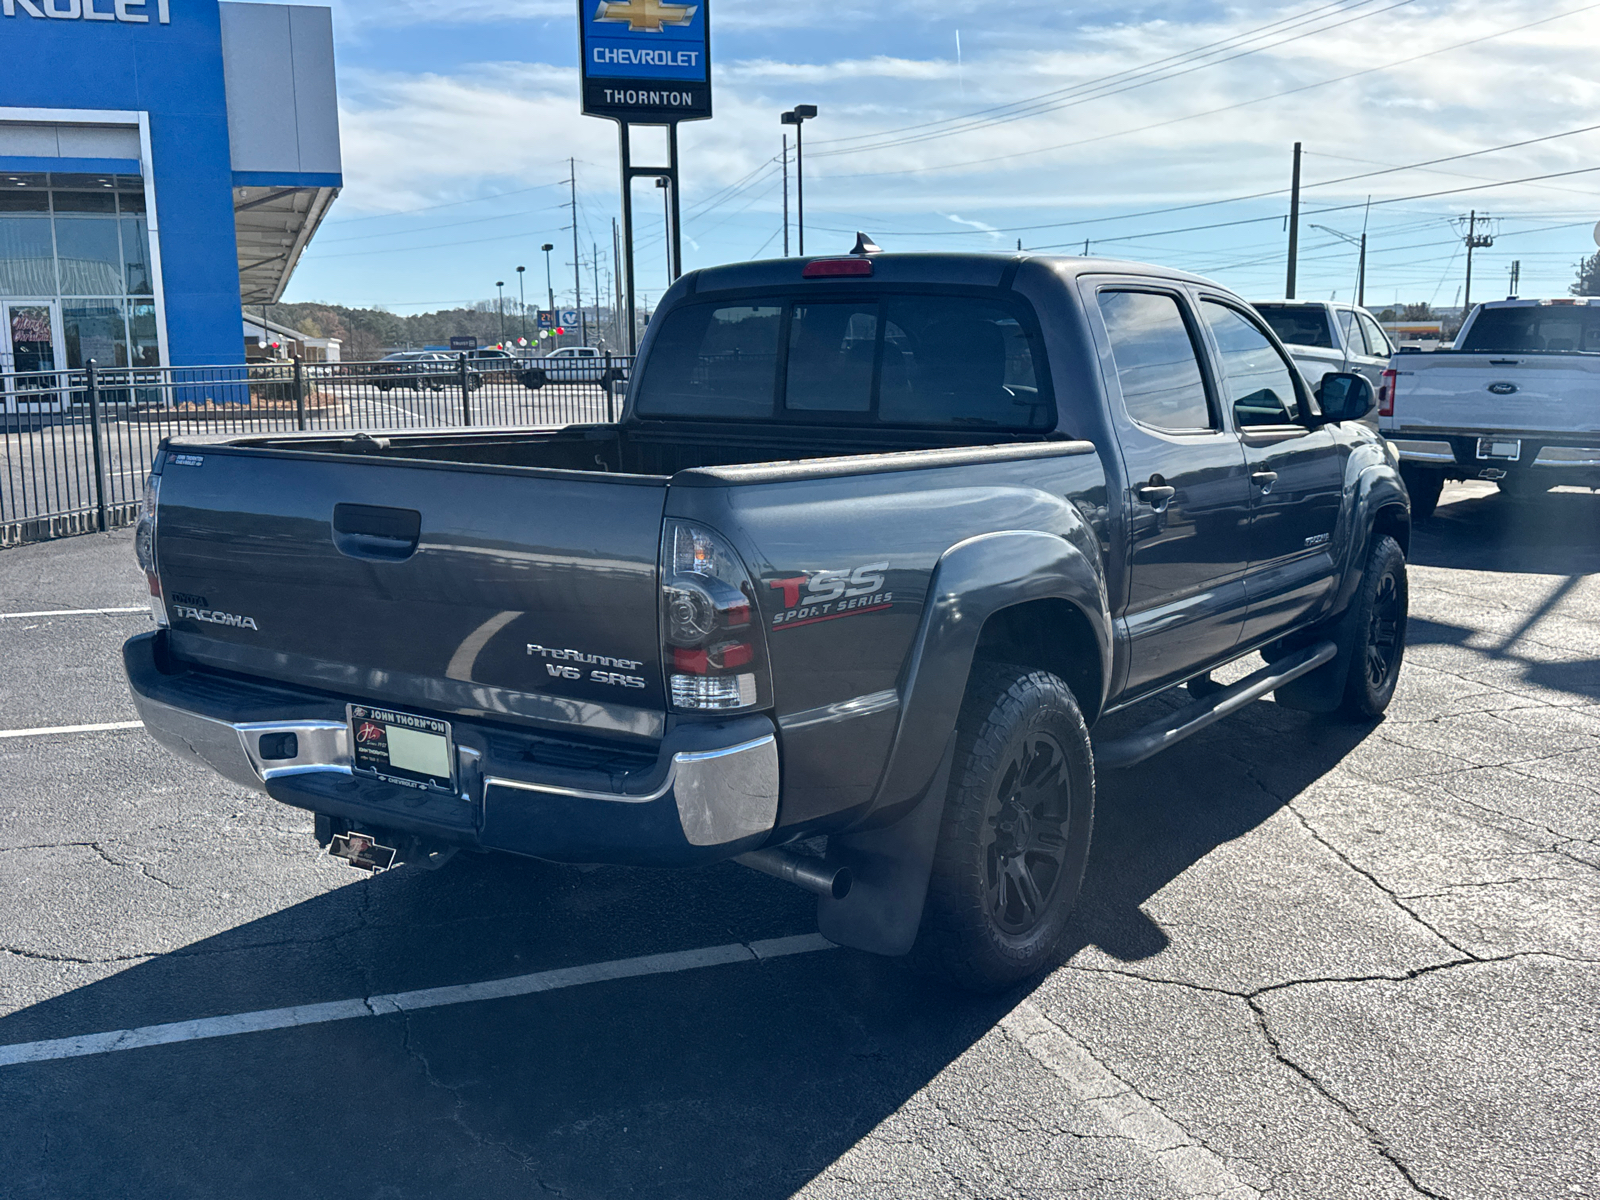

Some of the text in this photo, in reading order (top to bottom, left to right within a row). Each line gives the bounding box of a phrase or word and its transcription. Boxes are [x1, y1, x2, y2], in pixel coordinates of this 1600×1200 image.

[593, 47, 699, 66] CHEVROLET
[604, 89, 692, 106] THORNTON
[769, 561, 889, 609] TSS
[836, 592, 893, 611] SERIES
[172, 604, 258, 631] TACOMA
[526, 643, 643, 670] PreRunner
[545, 663, 645, 689] V6 SR5
[370, 709, 395, 723] JOHN
[387, 777, 418, 788] CHEVROLET
